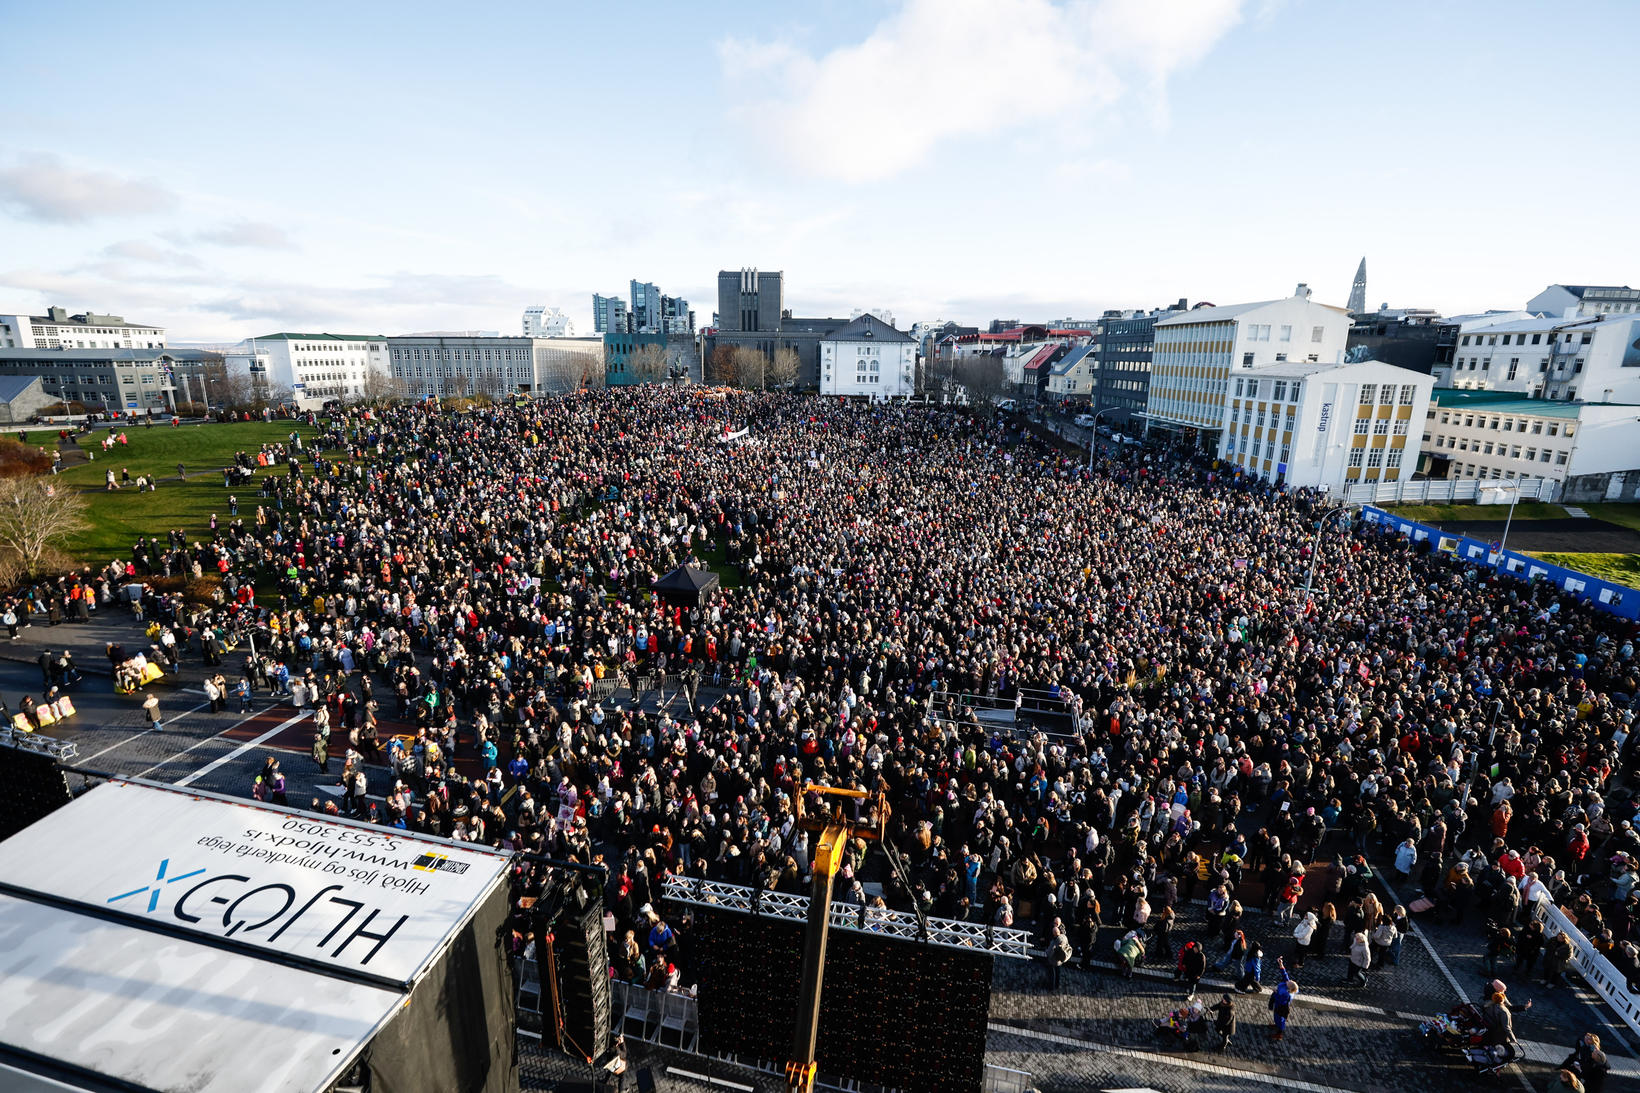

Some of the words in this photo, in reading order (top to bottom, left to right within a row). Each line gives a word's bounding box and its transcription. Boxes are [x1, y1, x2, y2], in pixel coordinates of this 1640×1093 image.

[1317, 403, 1332, 432] kastrup
[282, 820, 337, 838] 3050
[196, 835, 237, 855] leiga
[242, 828, 409, 871] www.hljodx.is
[235, 844, 322, 870] myndkerfa
[322, 860, 347, 875] og
[346, 869, 379, 886] ljós
